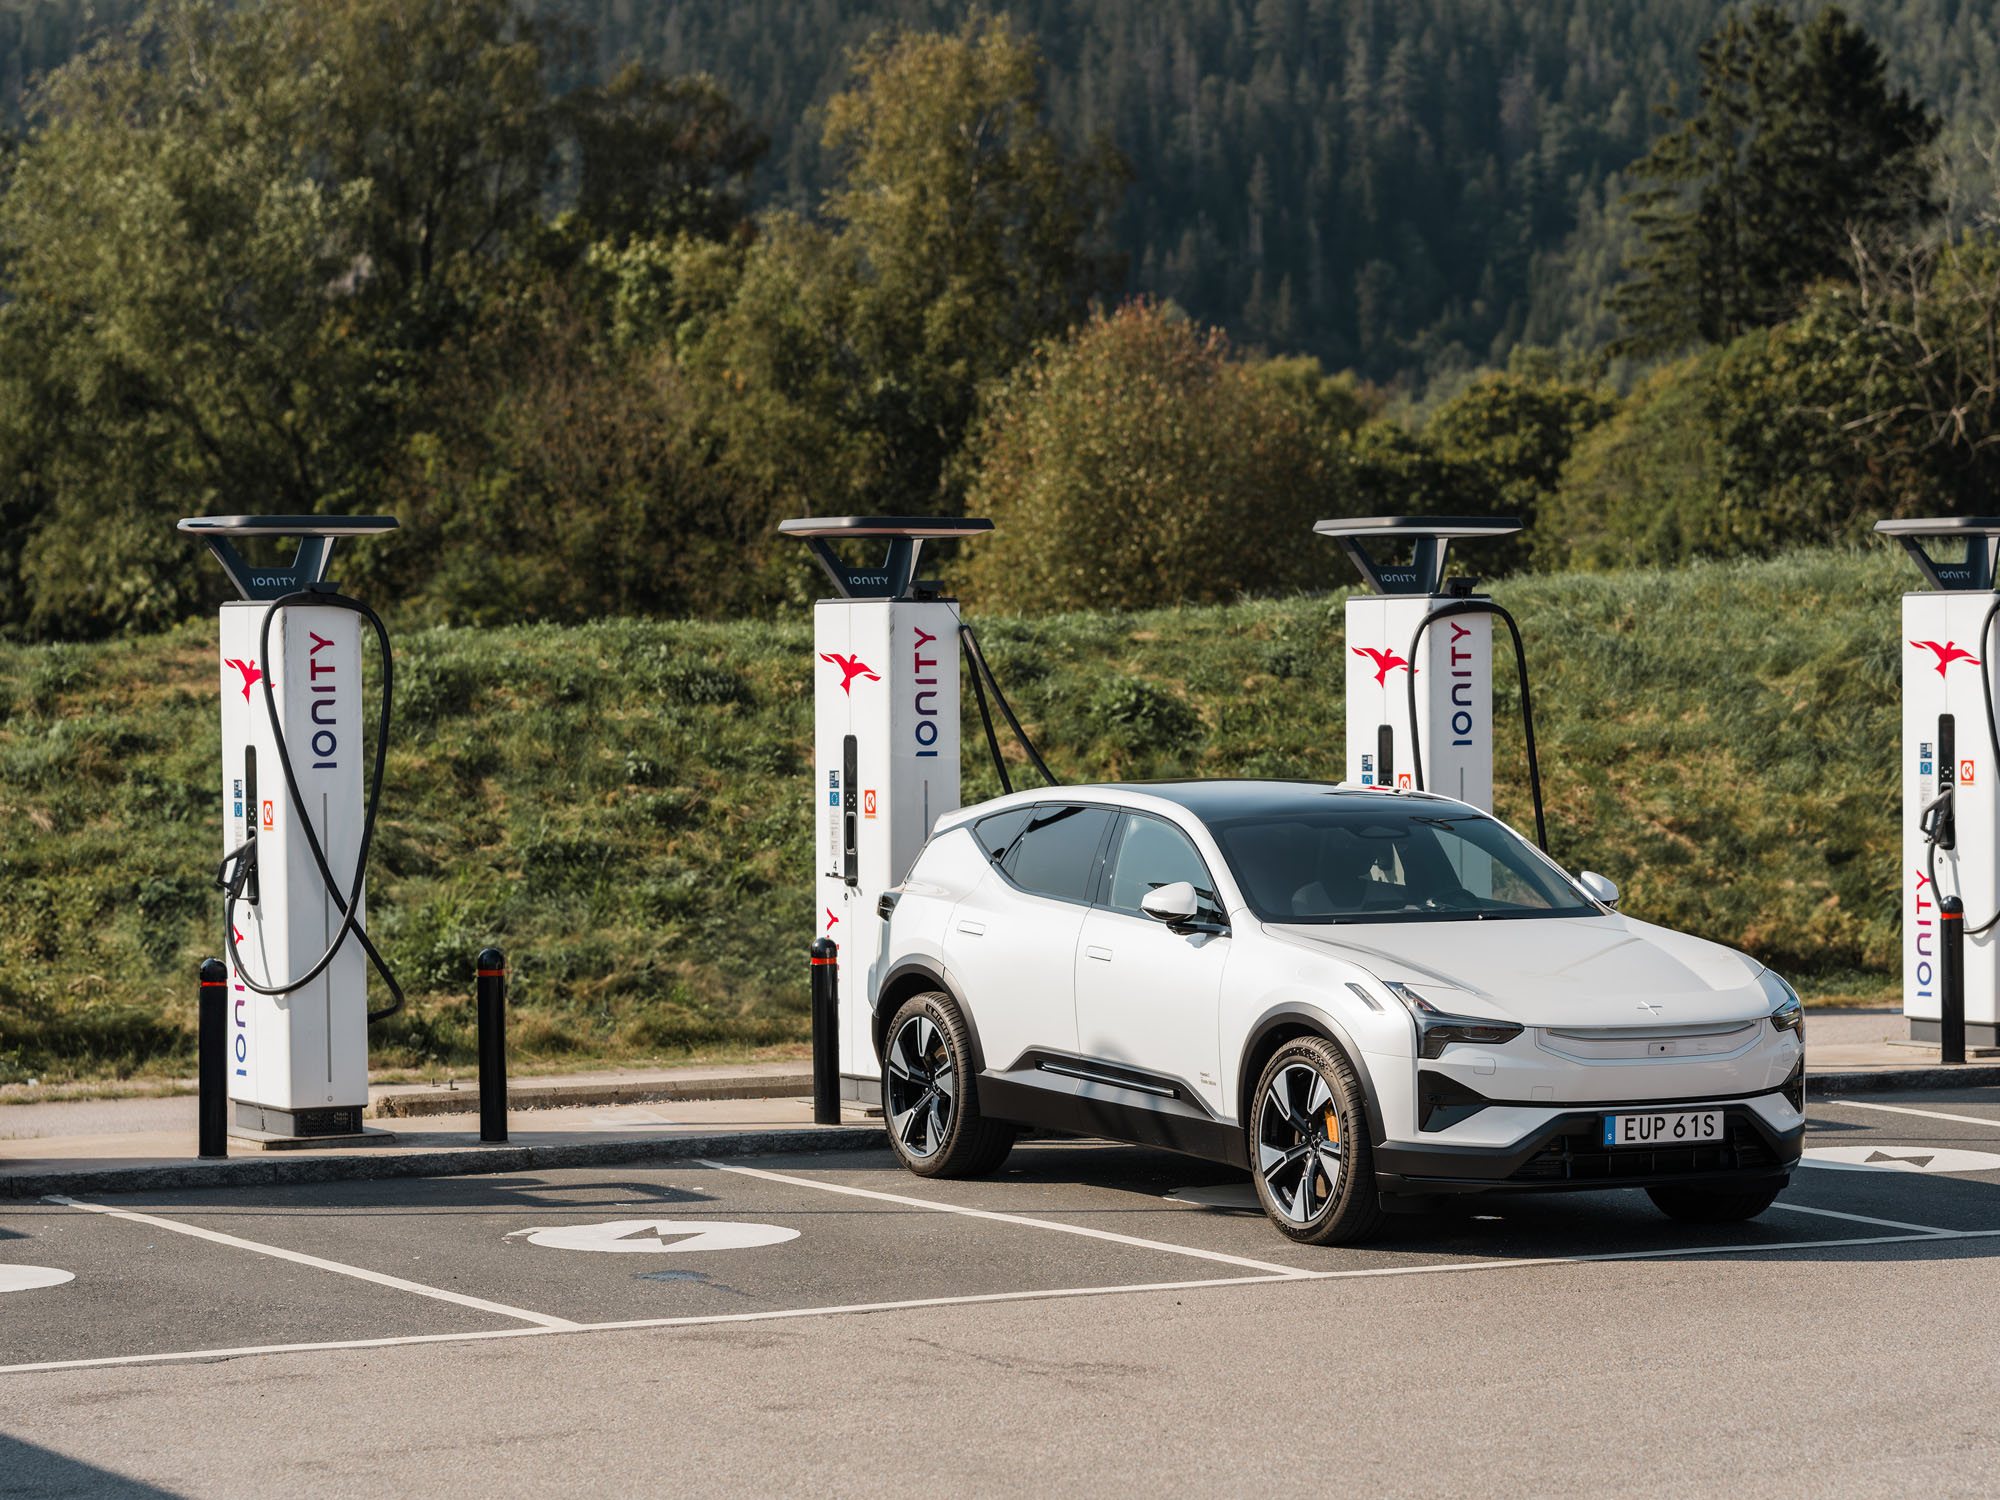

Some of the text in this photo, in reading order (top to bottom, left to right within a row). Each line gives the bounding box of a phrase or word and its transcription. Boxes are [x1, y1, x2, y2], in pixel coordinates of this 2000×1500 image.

[252, 577, 296, 586] IONITY
[848, 576, 888, 585] IONITY
[1380, 574, 1416, 582] IONITY
[1938, 571, 1970, 579] IONITY
[914, 626, 938, 757] IONITY
[1451, 621, 1472, 746] IONITY
[310, 631, 337, 769] IONITY
[833, 860, 838, 871] 4
[1916, 869, 1932, 997] IONITY
[1625, 1117, 1665, 1140] EUP
[1673, 1114, 1714, 1138] 61S
